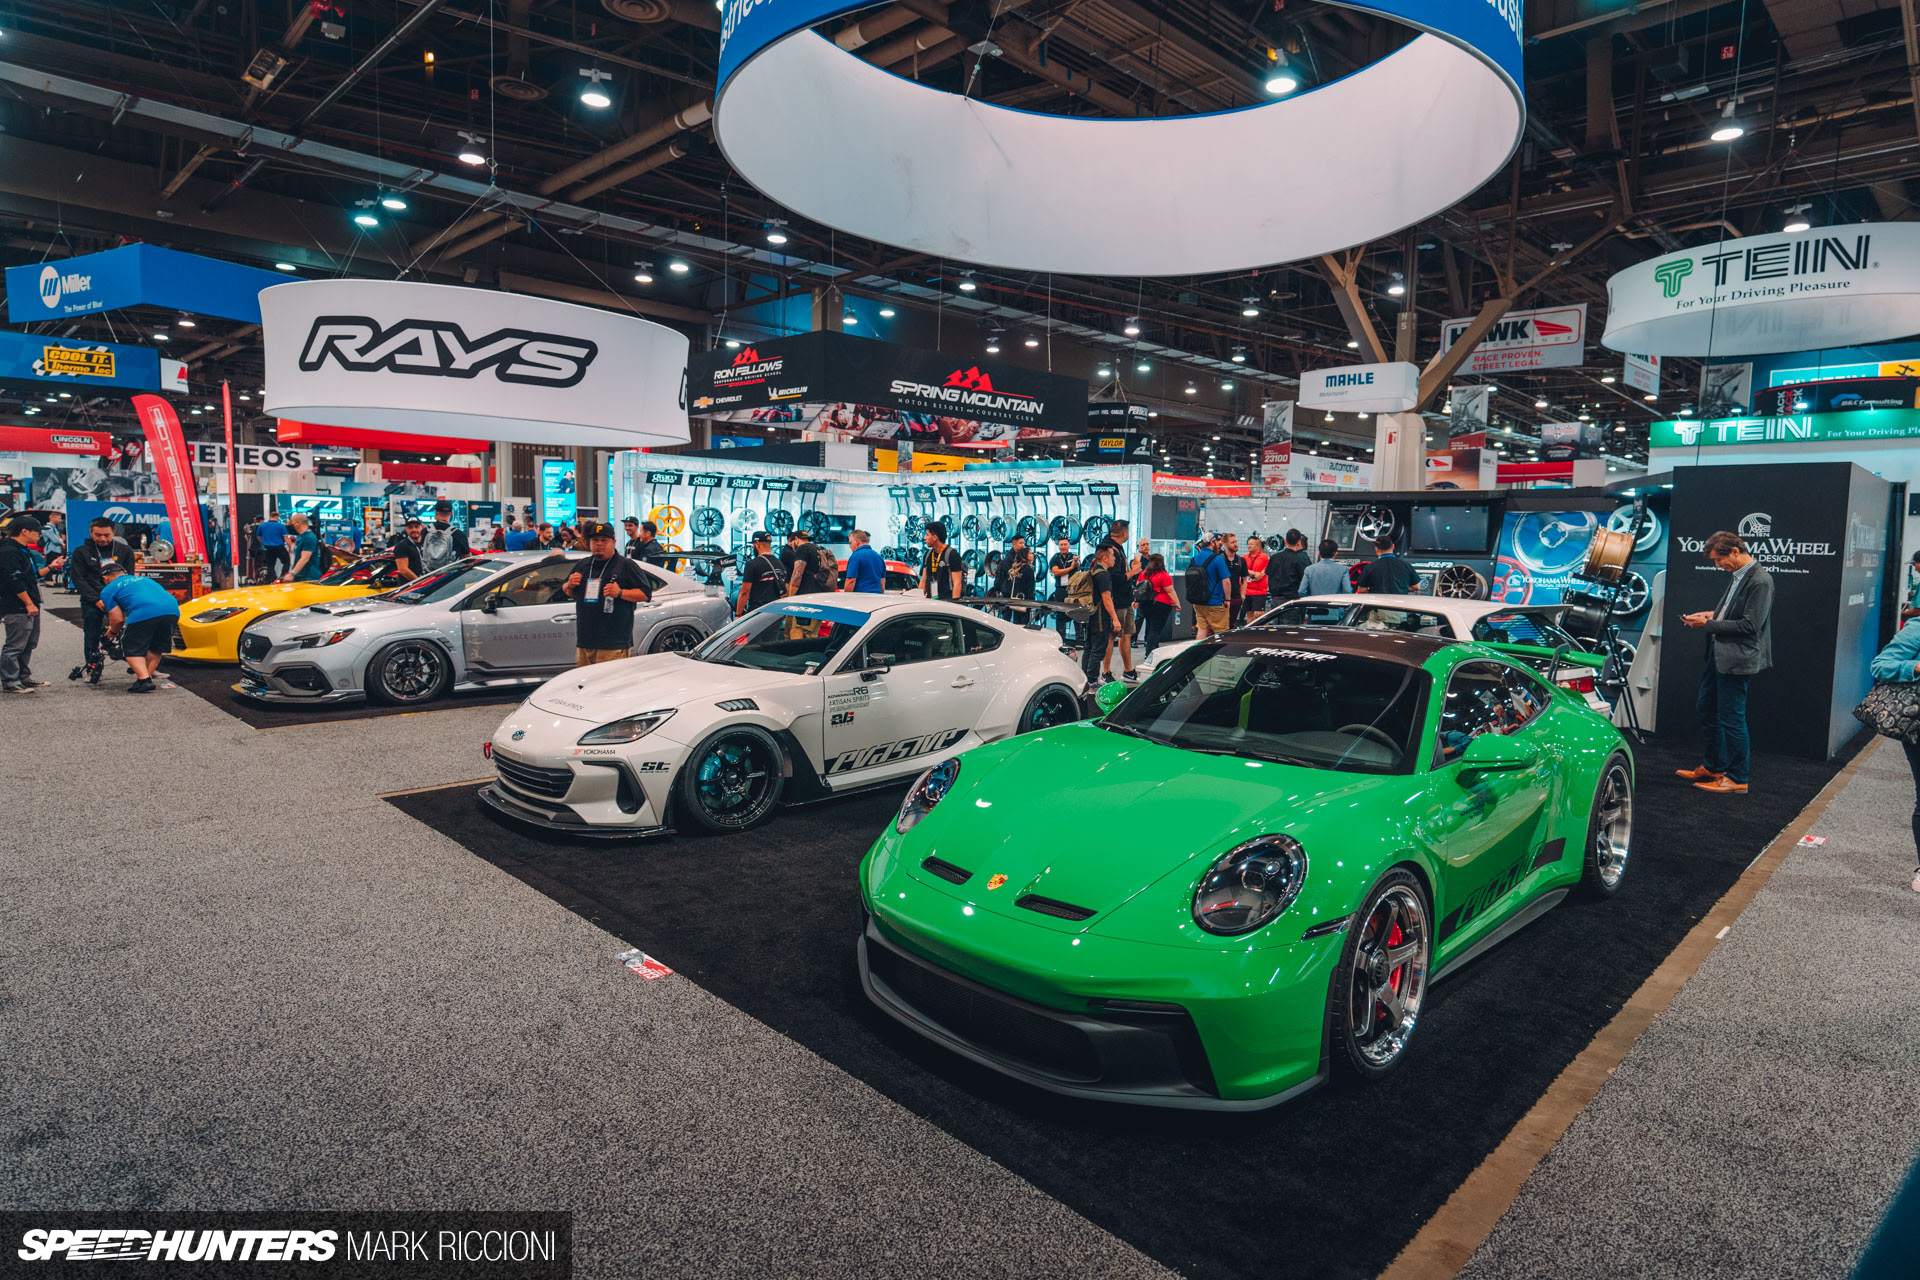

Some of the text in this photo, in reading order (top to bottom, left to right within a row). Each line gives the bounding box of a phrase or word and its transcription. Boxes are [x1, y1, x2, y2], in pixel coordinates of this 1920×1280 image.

[1702, 234, 1870, 287] TEIN
[62, 273, 91, 294] Miller
[1676, 279, 1851, 310] For Your Driving Pleasure
[73, 303, 86, 312] Power
[1450, 319, 1530, 346] HWK
[49, 350, 87, 362] COOL
[299, 315, 598, 388] RAYS
[1474, 350, 1543, 362] RACE PROVEN.
[52, 362, 111, 375] Thermo Tec
[714, 360, 783, 380] RON FELLOWS
[1472, 360, 1543, 372] STREET LEGAL.
[1326, 372, 1374, 388] MAHLE
[778, 386, 808, 396] MICHELIN
[890, 379, 1044, 415] SPRING MOUNTAIN
[716, 395, 742, 404] CHEVROLET
[898, 398, 928, 407] MOTOR
[933, 403, 964, 412] RESORT
[976, 409, 1012, 419] COUNTRY
[1016, 414, 1034, 422] CLUB
[1709, 417, 1812, 442] TEIN
[1844, 428, 1866, 437] Your
[1868, 428, 1906, 437] Driving
[54, 436, 91, 444] LINCOLN
[200, 445, 301, 468] ENEOS
[1264, 454, 1288, 463] 23100
[652, 474, 677, 482] gram
[693, 476, 718, 486] gram
[732, 478, 755, 487] gram
[136, 514, 170, 524] Mille
[1767, 538, 1836, 555] WHEEL
[1758, 554, 1796, 563] DESIGN
[1522, 575, 1560, 584] YOKOHAMA
[853, 686, 868, 695] R6
[829, 698, 852, 706] ARTISAN
